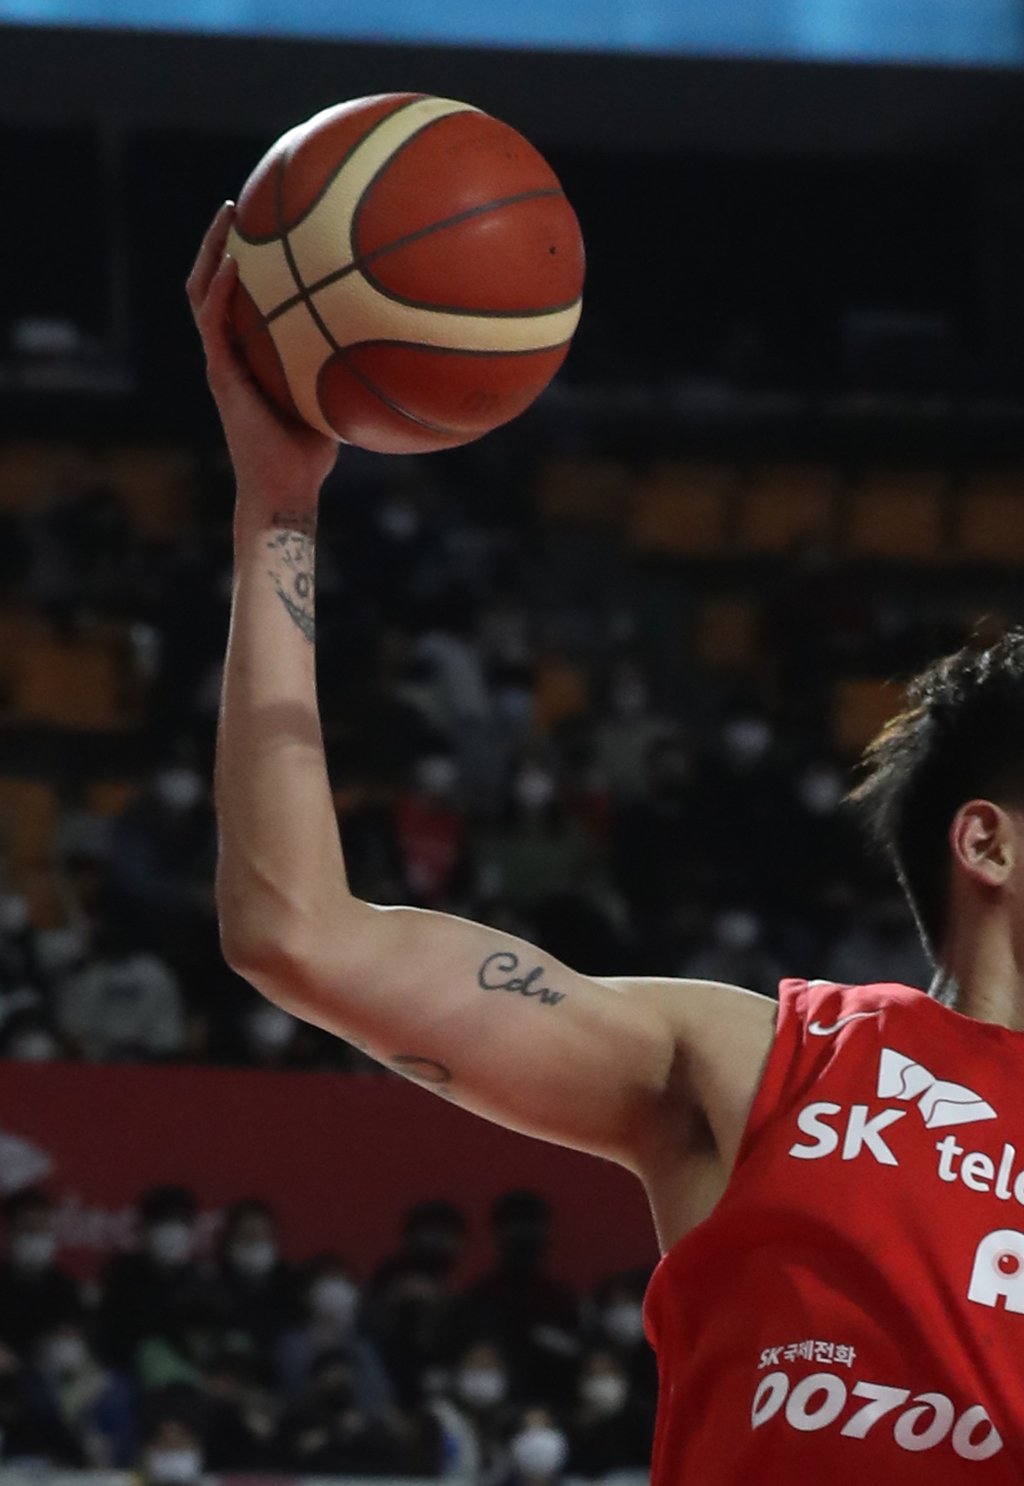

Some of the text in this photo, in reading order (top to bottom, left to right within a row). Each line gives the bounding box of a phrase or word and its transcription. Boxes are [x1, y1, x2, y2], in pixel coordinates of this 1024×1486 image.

[789, 1101, 906, 1166] SK
[757, 1340, 856, 1369] SK 국제전화
[751, 1371, 1004, 1461] 00700
